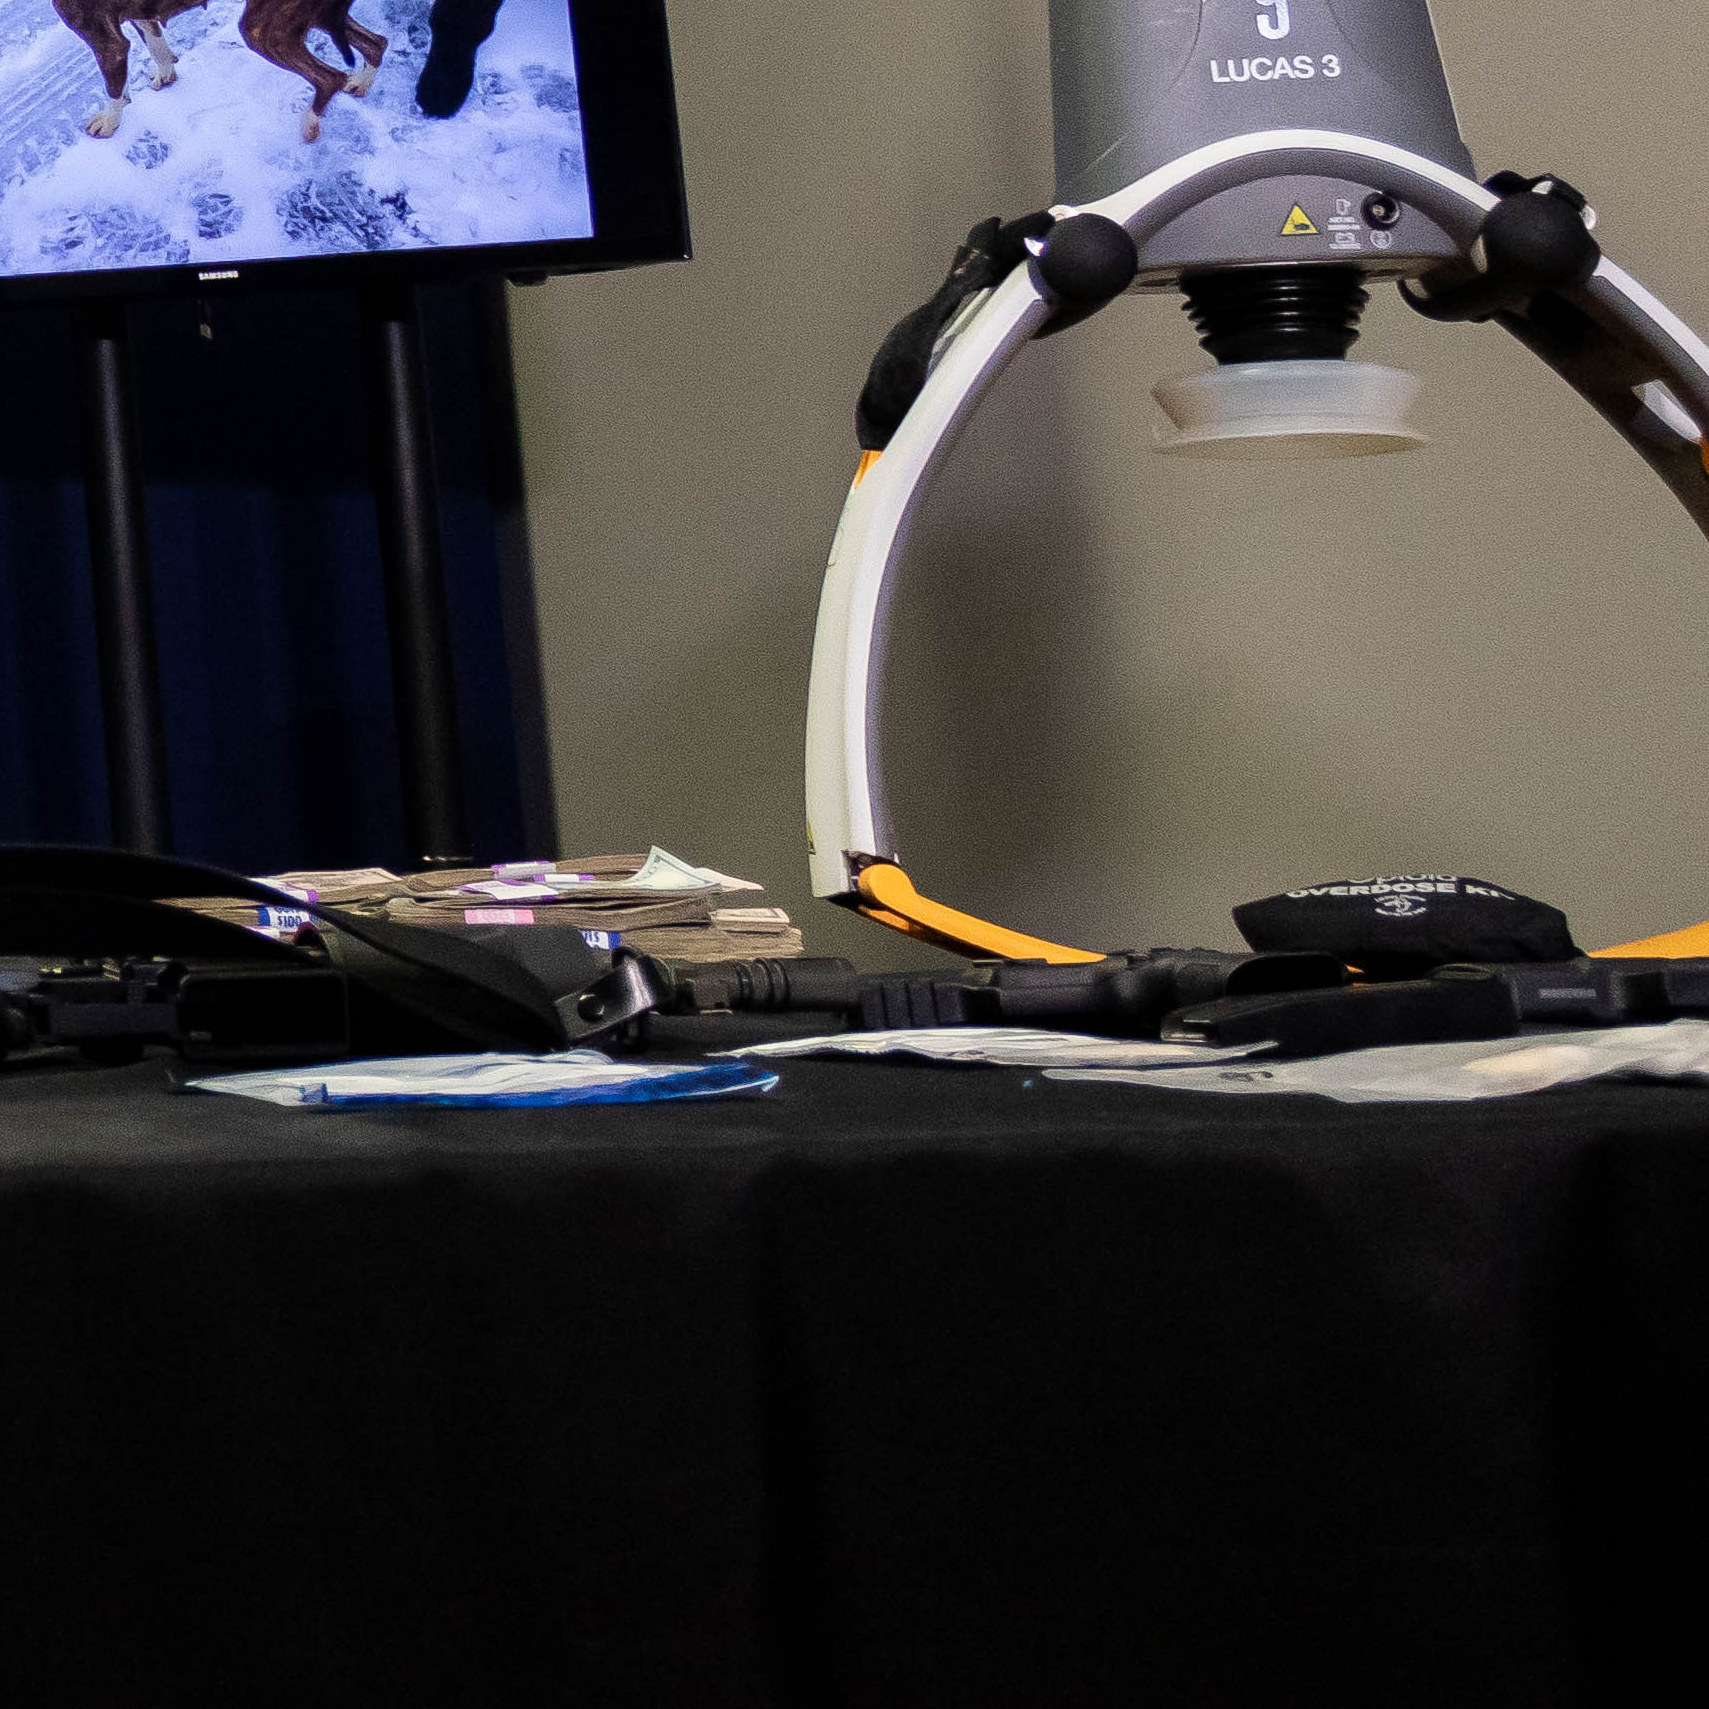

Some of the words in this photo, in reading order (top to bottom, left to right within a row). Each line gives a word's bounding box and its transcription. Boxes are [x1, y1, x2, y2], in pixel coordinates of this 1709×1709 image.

[1210, 55, 1316, 83] LUCAS
[1322, 54, 1341, 78] 3
[1284, 881, 1457, 898] OVERDOSE
